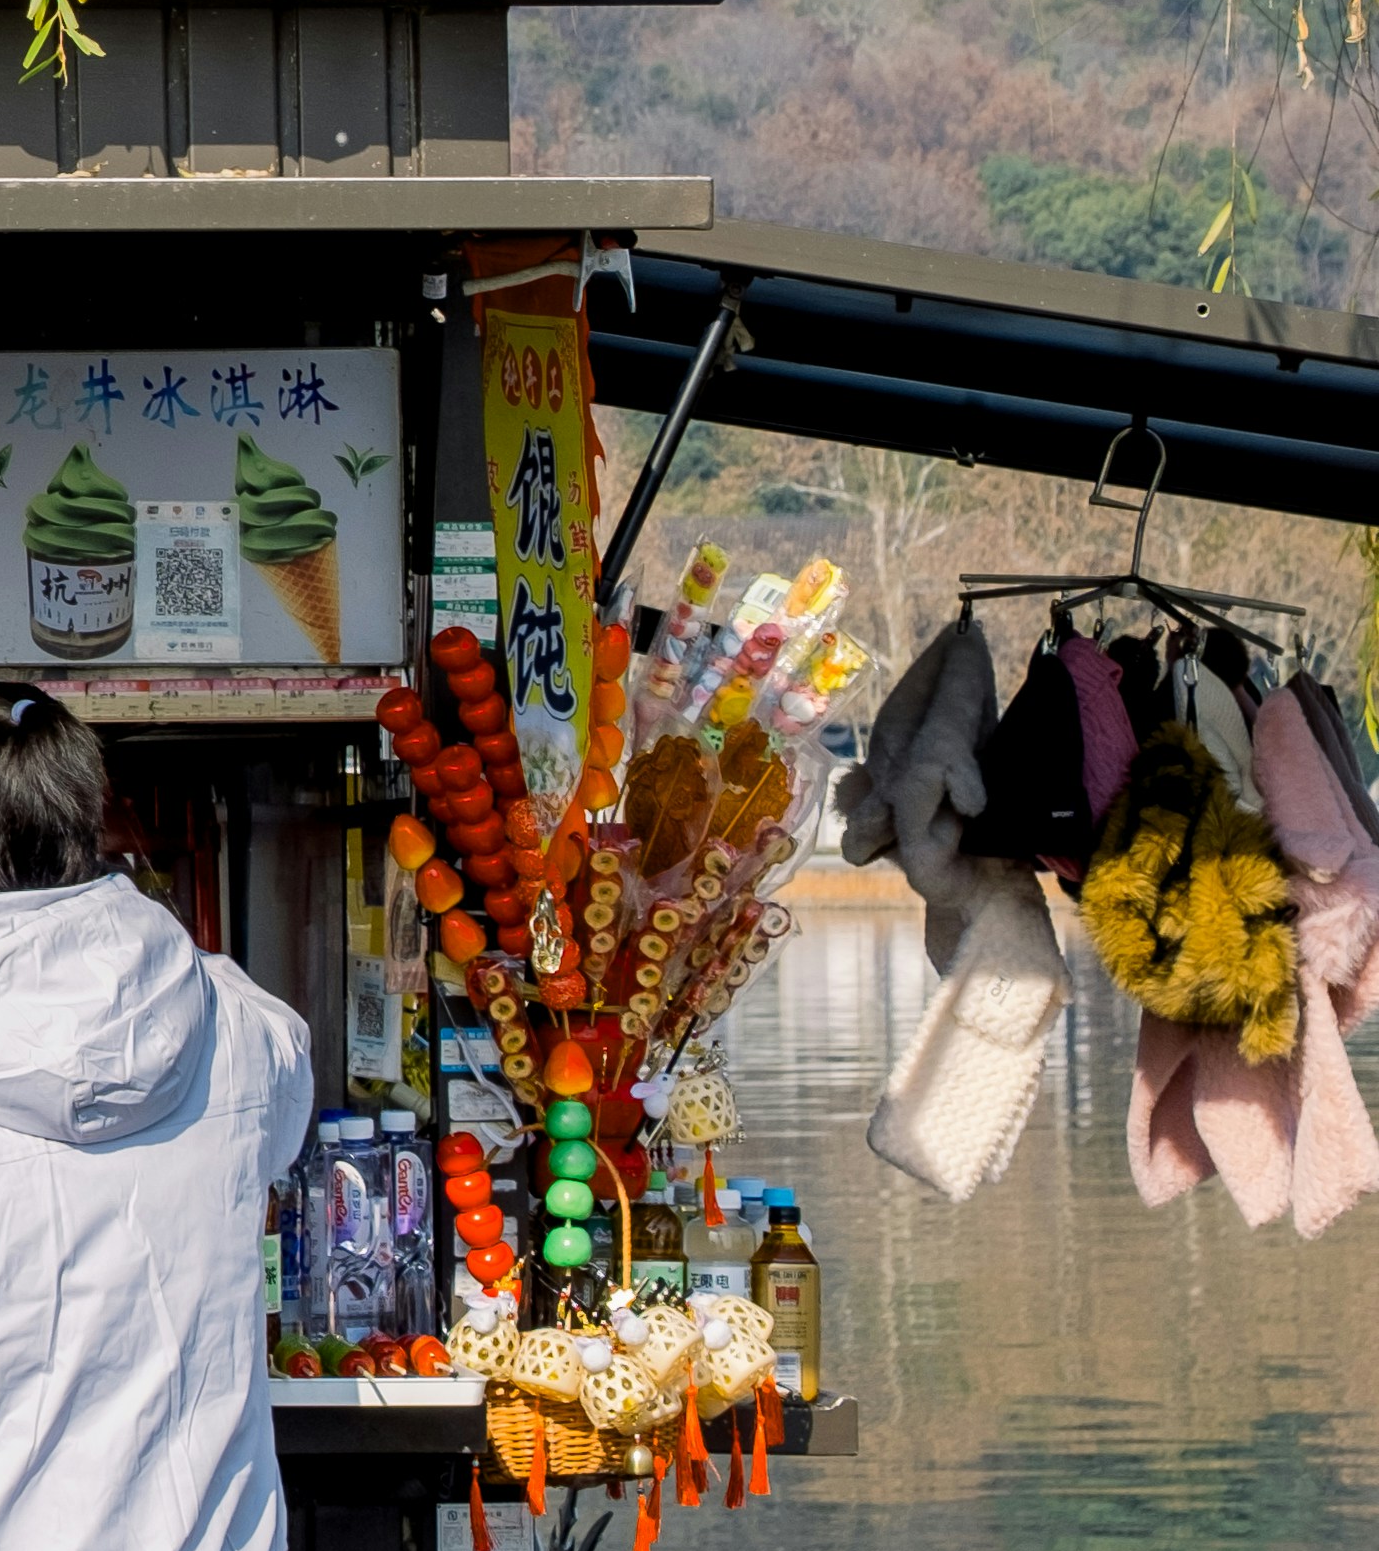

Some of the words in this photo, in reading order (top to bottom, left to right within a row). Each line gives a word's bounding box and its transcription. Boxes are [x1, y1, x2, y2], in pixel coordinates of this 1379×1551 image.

[5, 358, 340, 435] 龙井冰淇淋
[506, 420, 578, 720] 馄饨
